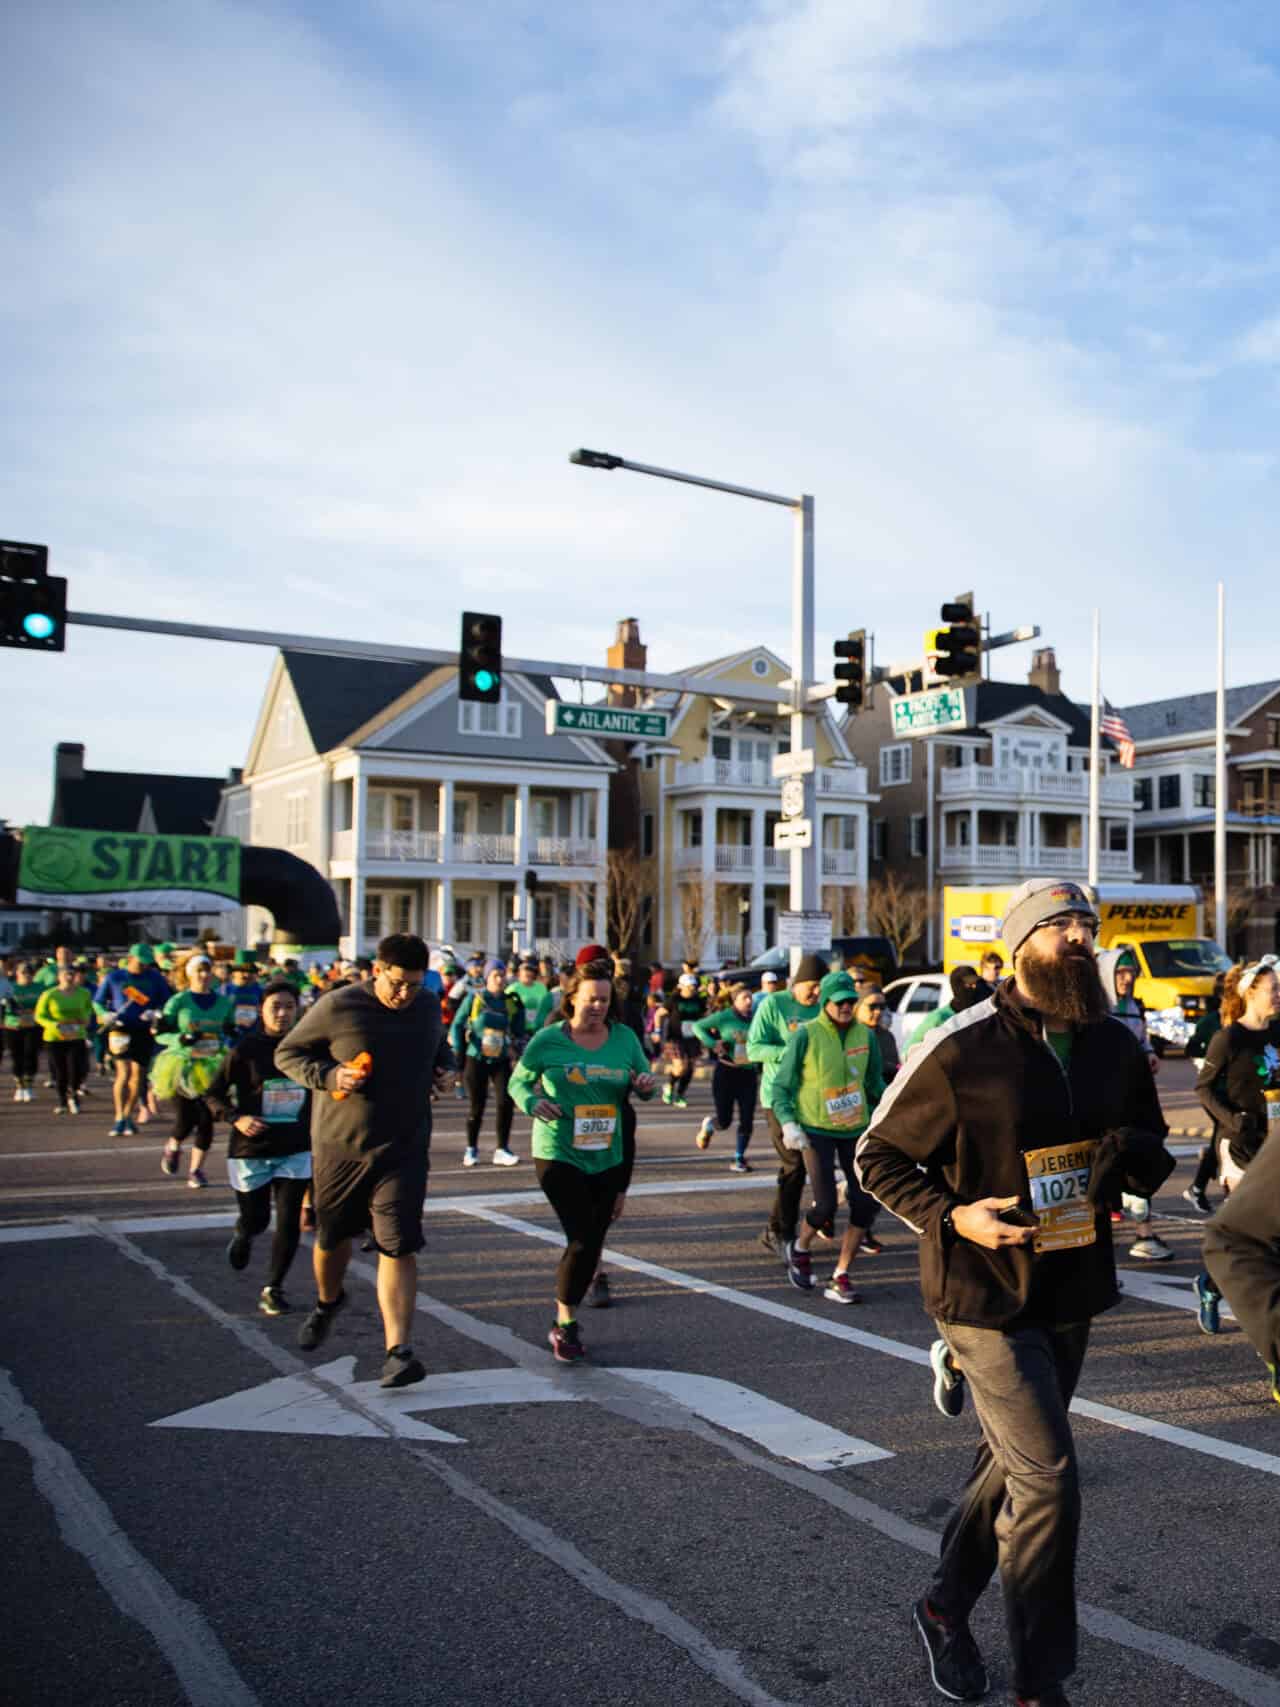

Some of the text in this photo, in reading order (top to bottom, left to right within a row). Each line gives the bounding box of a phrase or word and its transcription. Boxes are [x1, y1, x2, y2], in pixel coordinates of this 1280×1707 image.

[578, 710, 641, 733] ATLANTIC
[90, 836, 235, 882] START
[1107, 904, 1191, 919] PENSKE
[1040, 1151, 1093, 1173] JEREM
[1040, 1175, 1089, 1204] 1025
